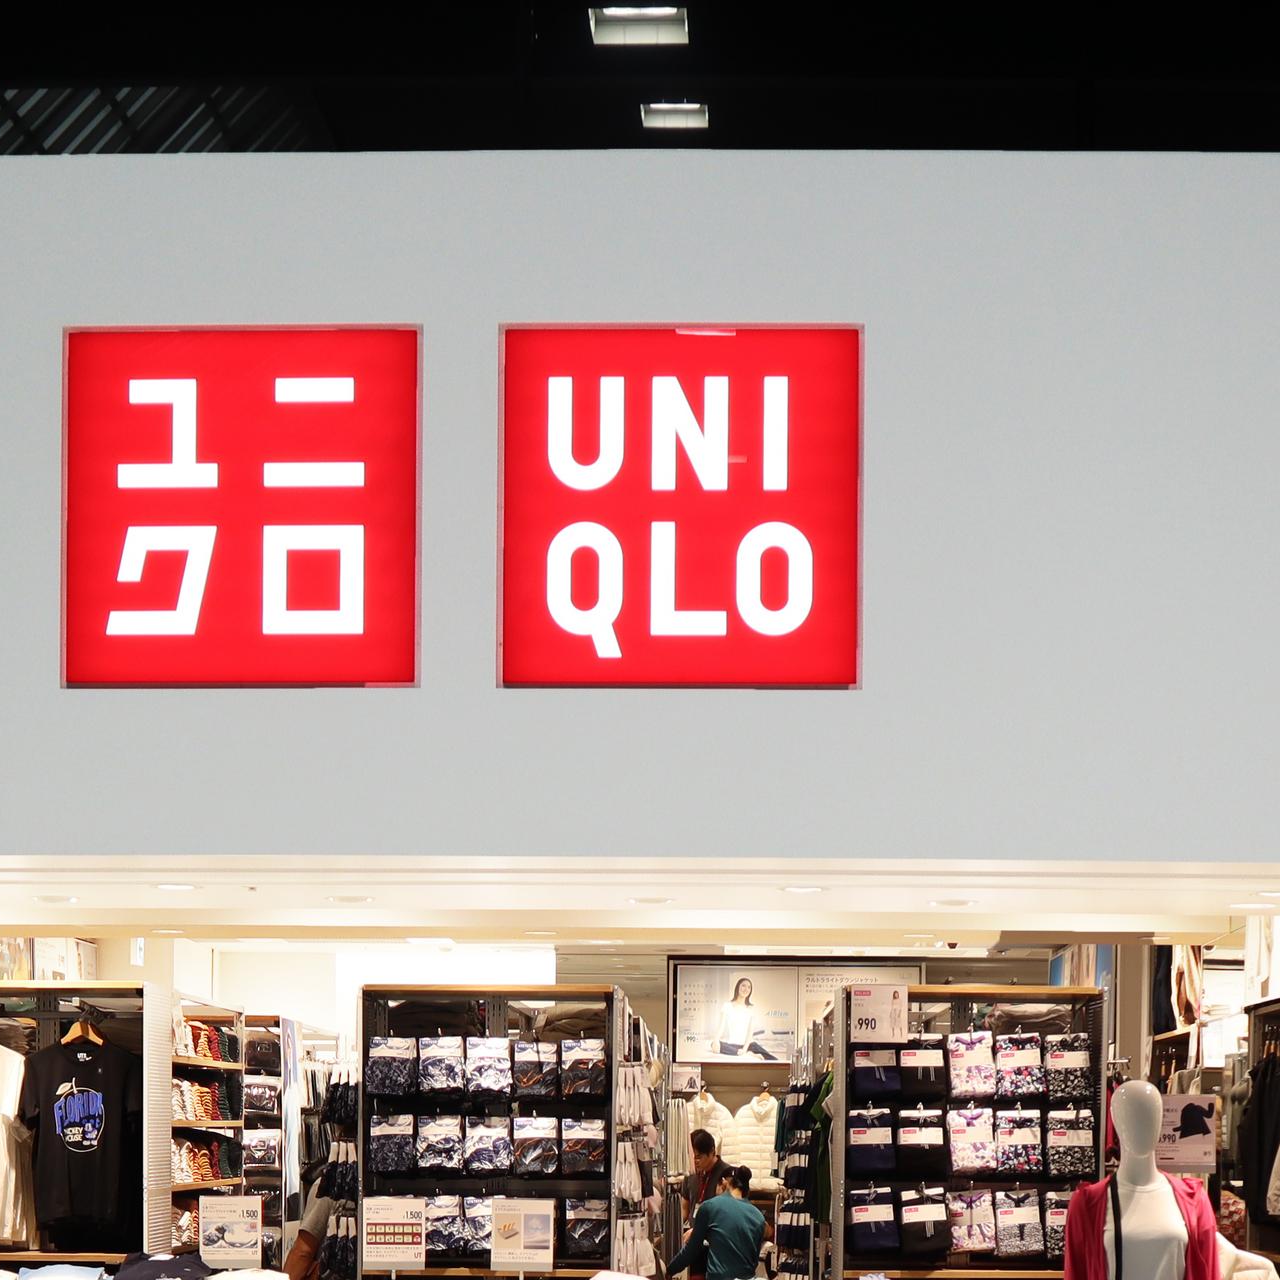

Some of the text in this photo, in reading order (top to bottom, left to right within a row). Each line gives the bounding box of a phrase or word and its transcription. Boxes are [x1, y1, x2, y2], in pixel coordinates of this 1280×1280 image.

[117, 377, 365, 488] ユニ
[547, 376, 788, 491] UNI
[105, 524, 365, 635] クロ
[546, 521, 813, 658] QLO
